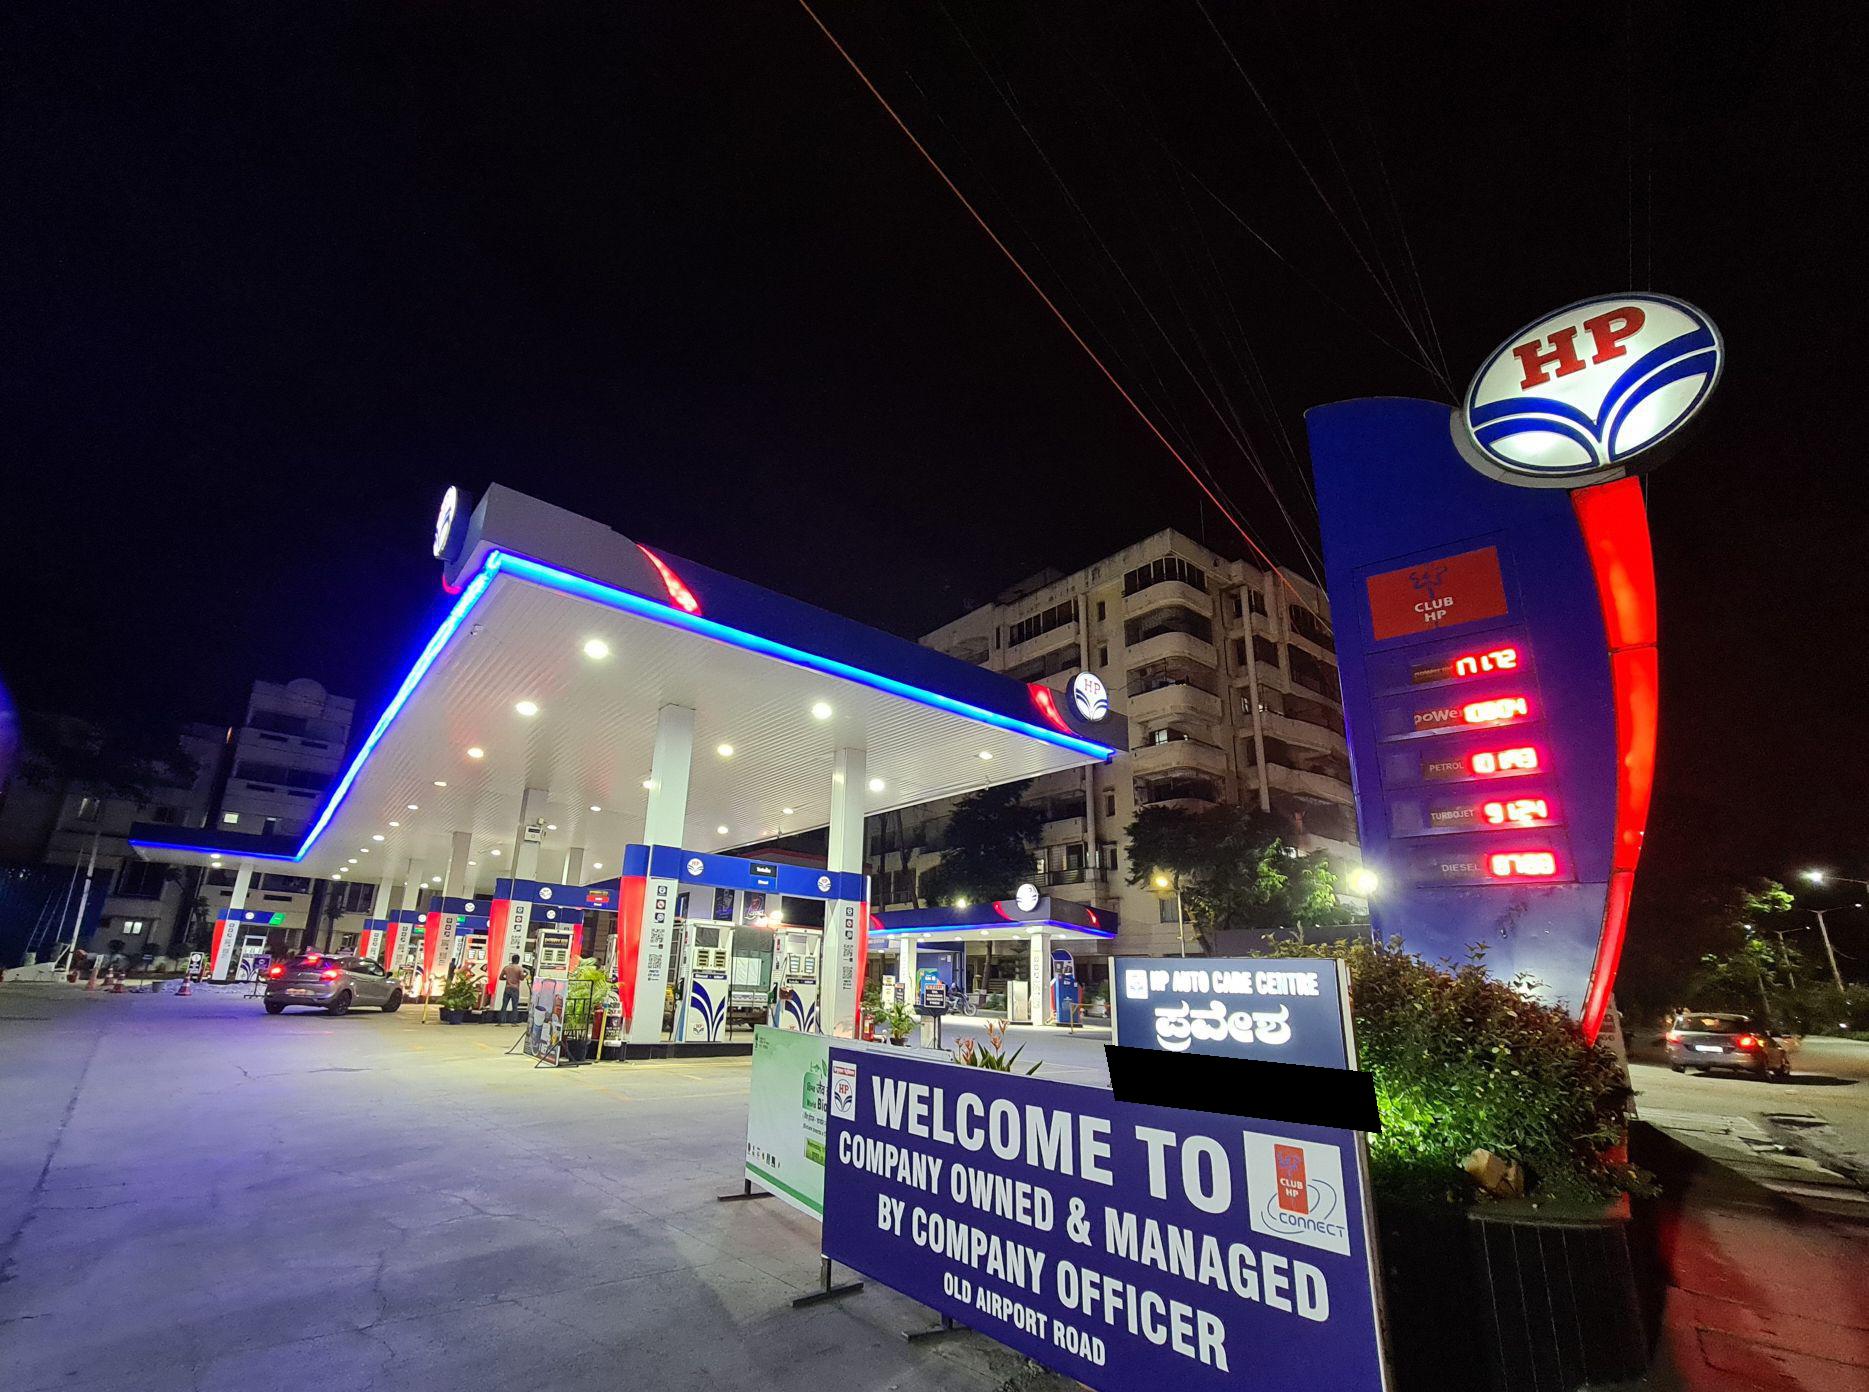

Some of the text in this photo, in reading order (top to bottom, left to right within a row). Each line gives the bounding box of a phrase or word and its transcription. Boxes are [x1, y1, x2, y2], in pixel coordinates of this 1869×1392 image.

[1512, 306, 1646, 390] HP
[1414, 597, 1454, 612] CLUB
[1424, 610, 1447, 622] HP
[1084, 678, 1101, 694] HP
[1429, 762, 1464, 772] PETROL
[1431, 809, 1474, 821] TURBOJET
[1441, 863, 1481, 872] DIESEL
[1172, 970, 1210, 993] AUTO
[1212, 970, 1253, 994] CARE
[1255, 971, 1320, 996] CENTRE
[1154, 1000, 1292, 1052] ಪ್ರವೇಶ
[838, 1084, 849, 1095] HP
[872, 1075, 1232, 1214] WELCOME TO
[1280, 1178, 1304, 1190] CLUB
[1285, 1188, 1299, 1198] HP
[839, 1131, 1329, 1322] COMPANY OWNED & MANAGED
[878, 1193, 1230, 1373] BY COMPANY OFFICER
[943, 1272, 1106, 1367] OLD AIRPORT ROAD
